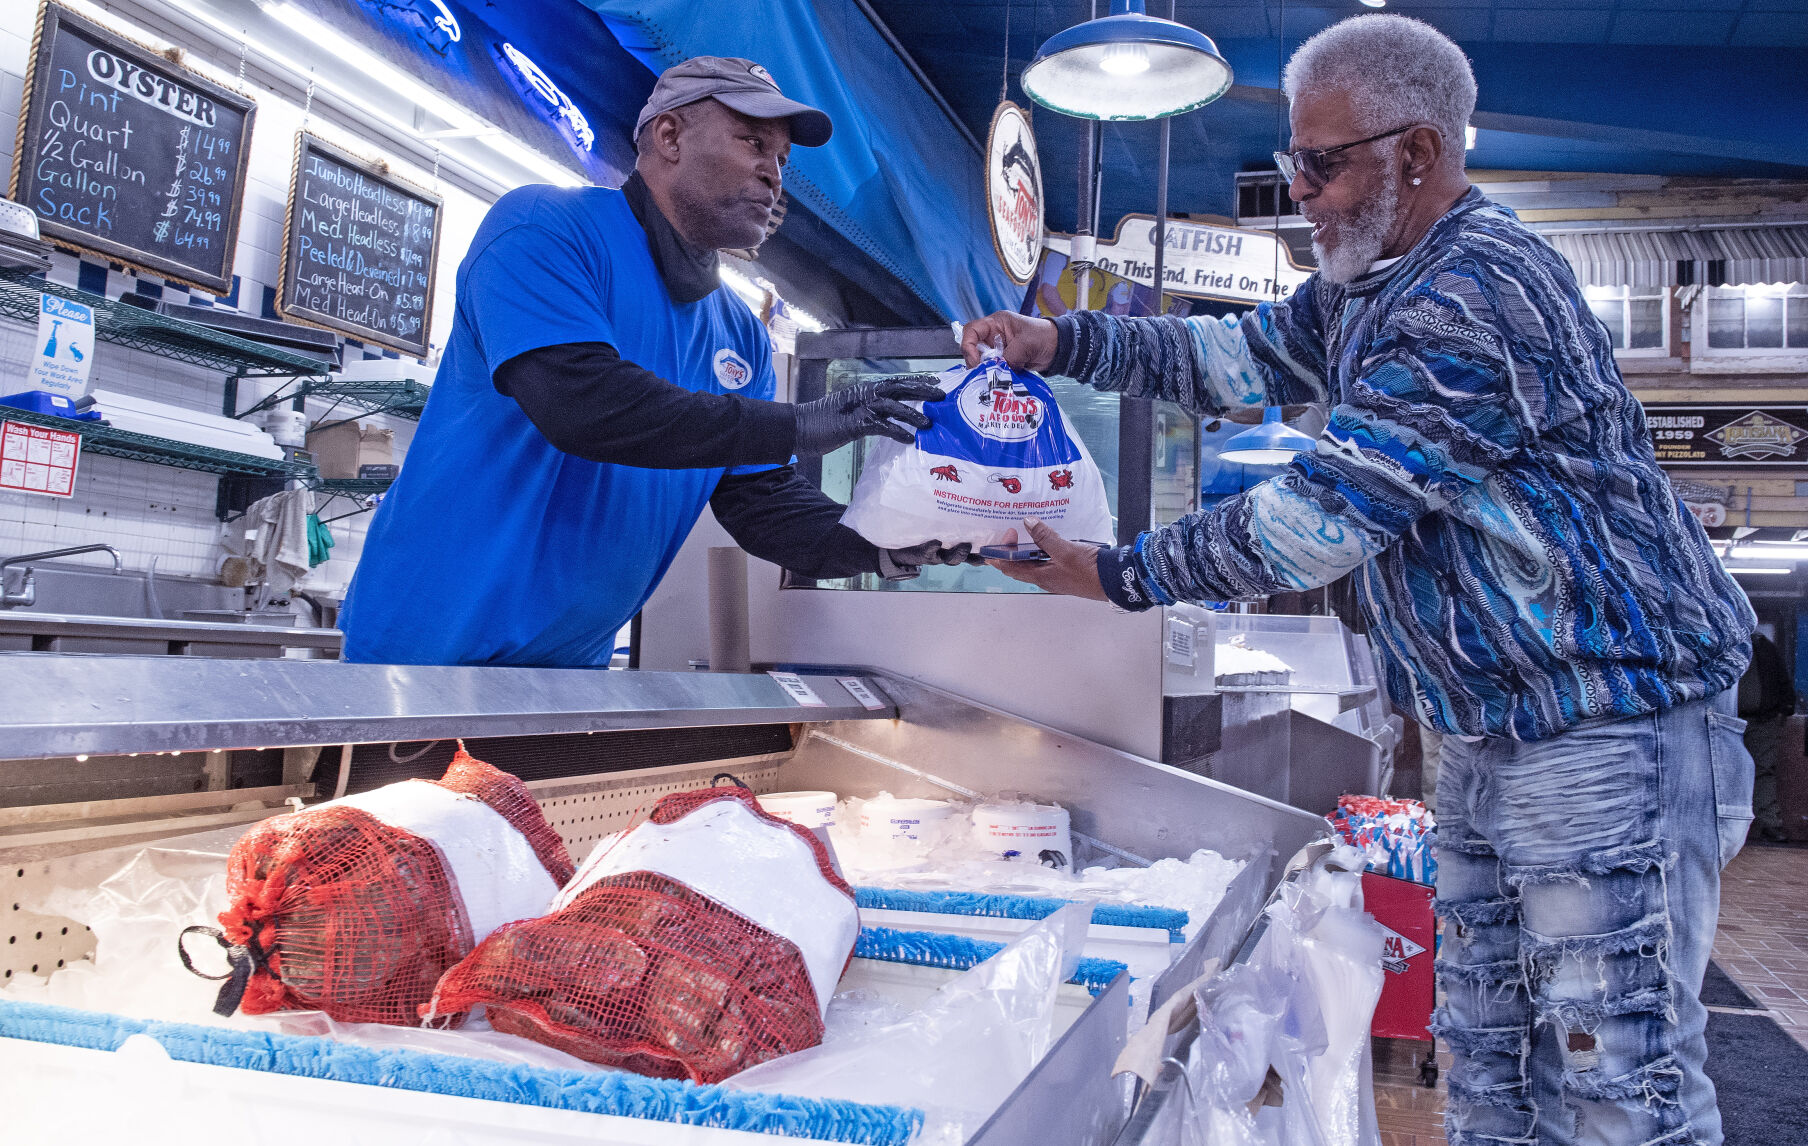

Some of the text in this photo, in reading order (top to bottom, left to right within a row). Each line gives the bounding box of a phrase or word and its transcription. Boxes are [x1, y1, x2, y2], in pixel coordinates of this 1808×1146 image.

[59, 69, 123, 112] Pint
[88, 50, 216, 127] OYSTER
[50, 100, 133, 149] Quart
[38, 158, 116, 200] Gallon
[71, 140, 145, 185] Gallon
[37, 187, 112, 230] Sack
[348, 223, 397, 257] Headless
[1098, 257, 1118, 274] On
[1123, 259, 1154, 279] This
[1194, 269, 1233, 290] Fried
[1239, 276, 1258, 291] On
[1263, 278, 1289, 296] The
[46, 298, 88, 321] Please
[295, 283, 330, 313] Med
[6, 423, 76, 443] Wash Your Hands
[1646, 416, 1705, 429] ESTABLISHED
[1655, 430, 1694, 440] 1959
[933, 489, 1070, 509] INSTRUCTIONS FOR REFRIGERATION
